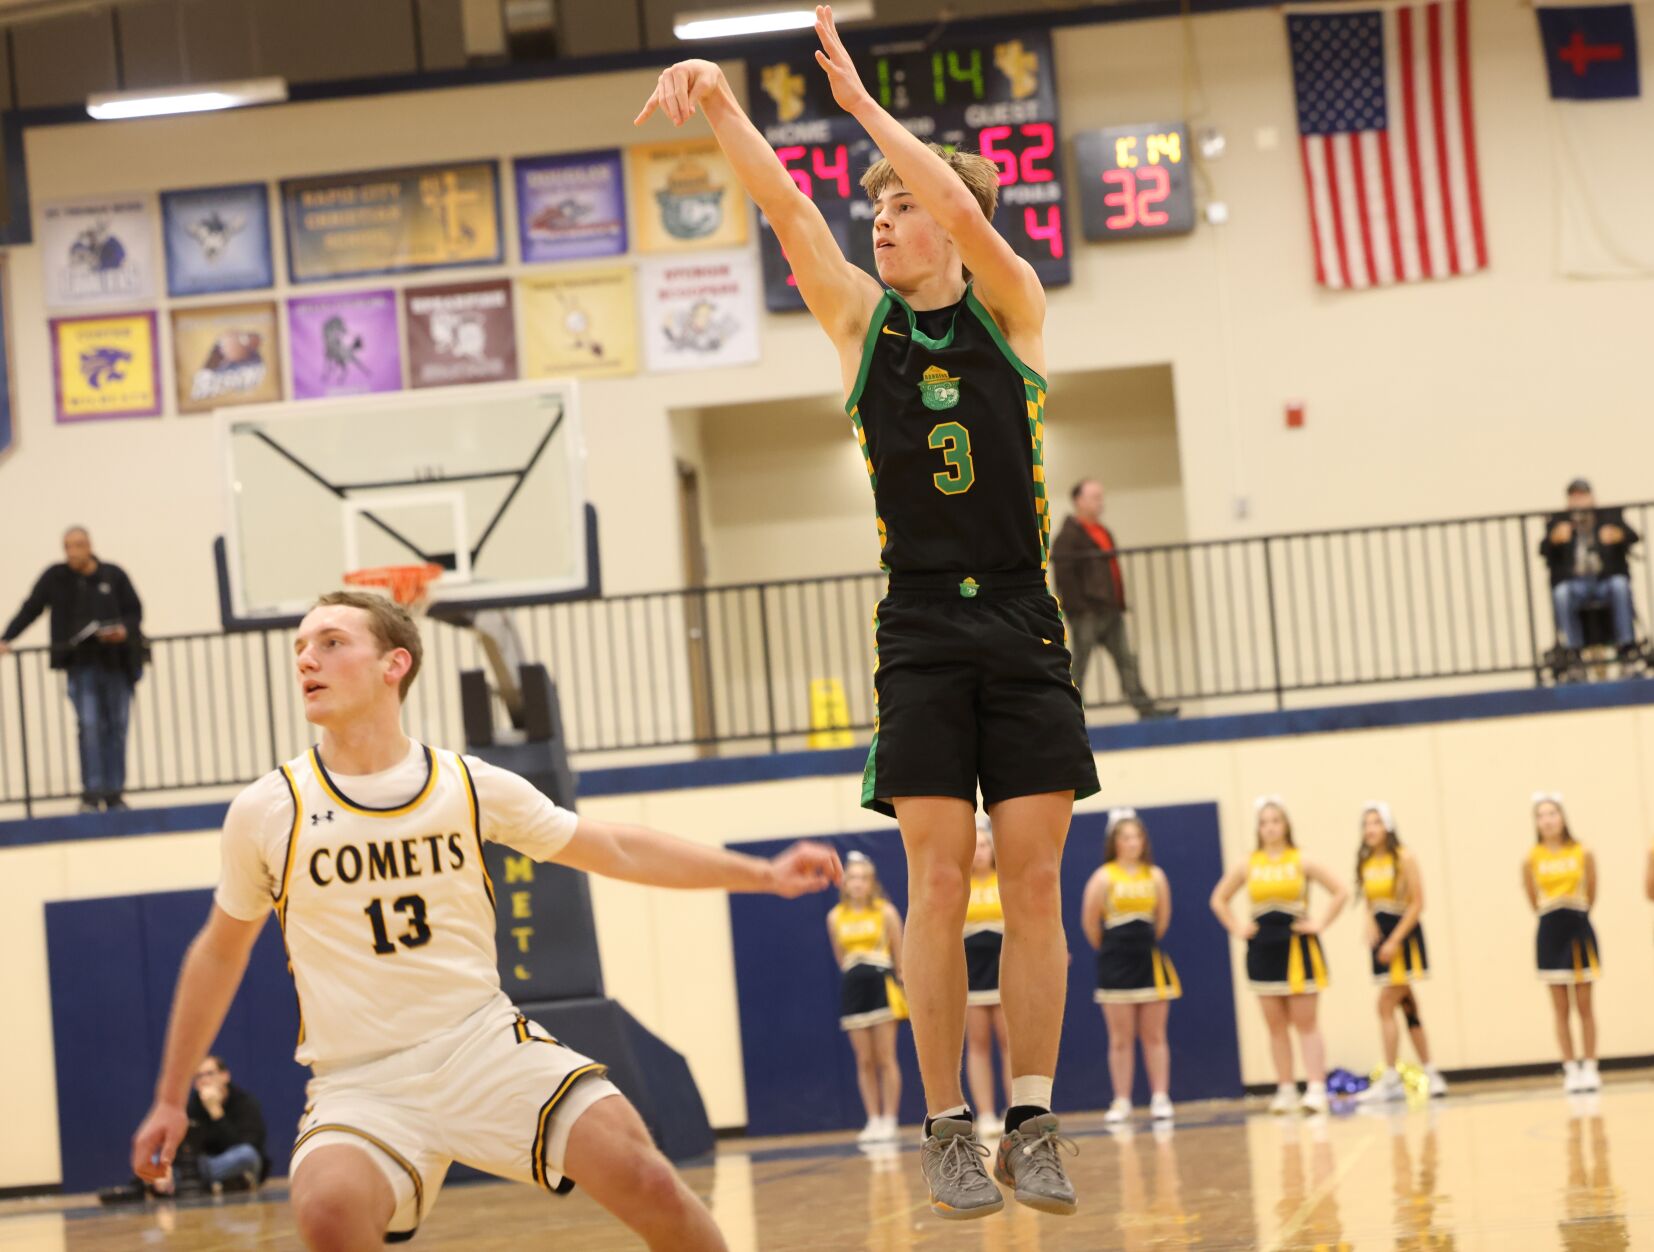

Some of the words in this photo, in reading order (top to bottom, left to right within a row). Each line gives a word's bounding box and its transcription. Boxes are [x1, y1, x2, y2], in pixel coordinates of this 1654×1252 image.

[1102, 165, 1171, 230] 32
[1024, 203, 1064, 259] 4
[927, 421, 975, 495] 3
[309, 832, 465, 886] COMETS
[364, 894, 432, 955] 13
